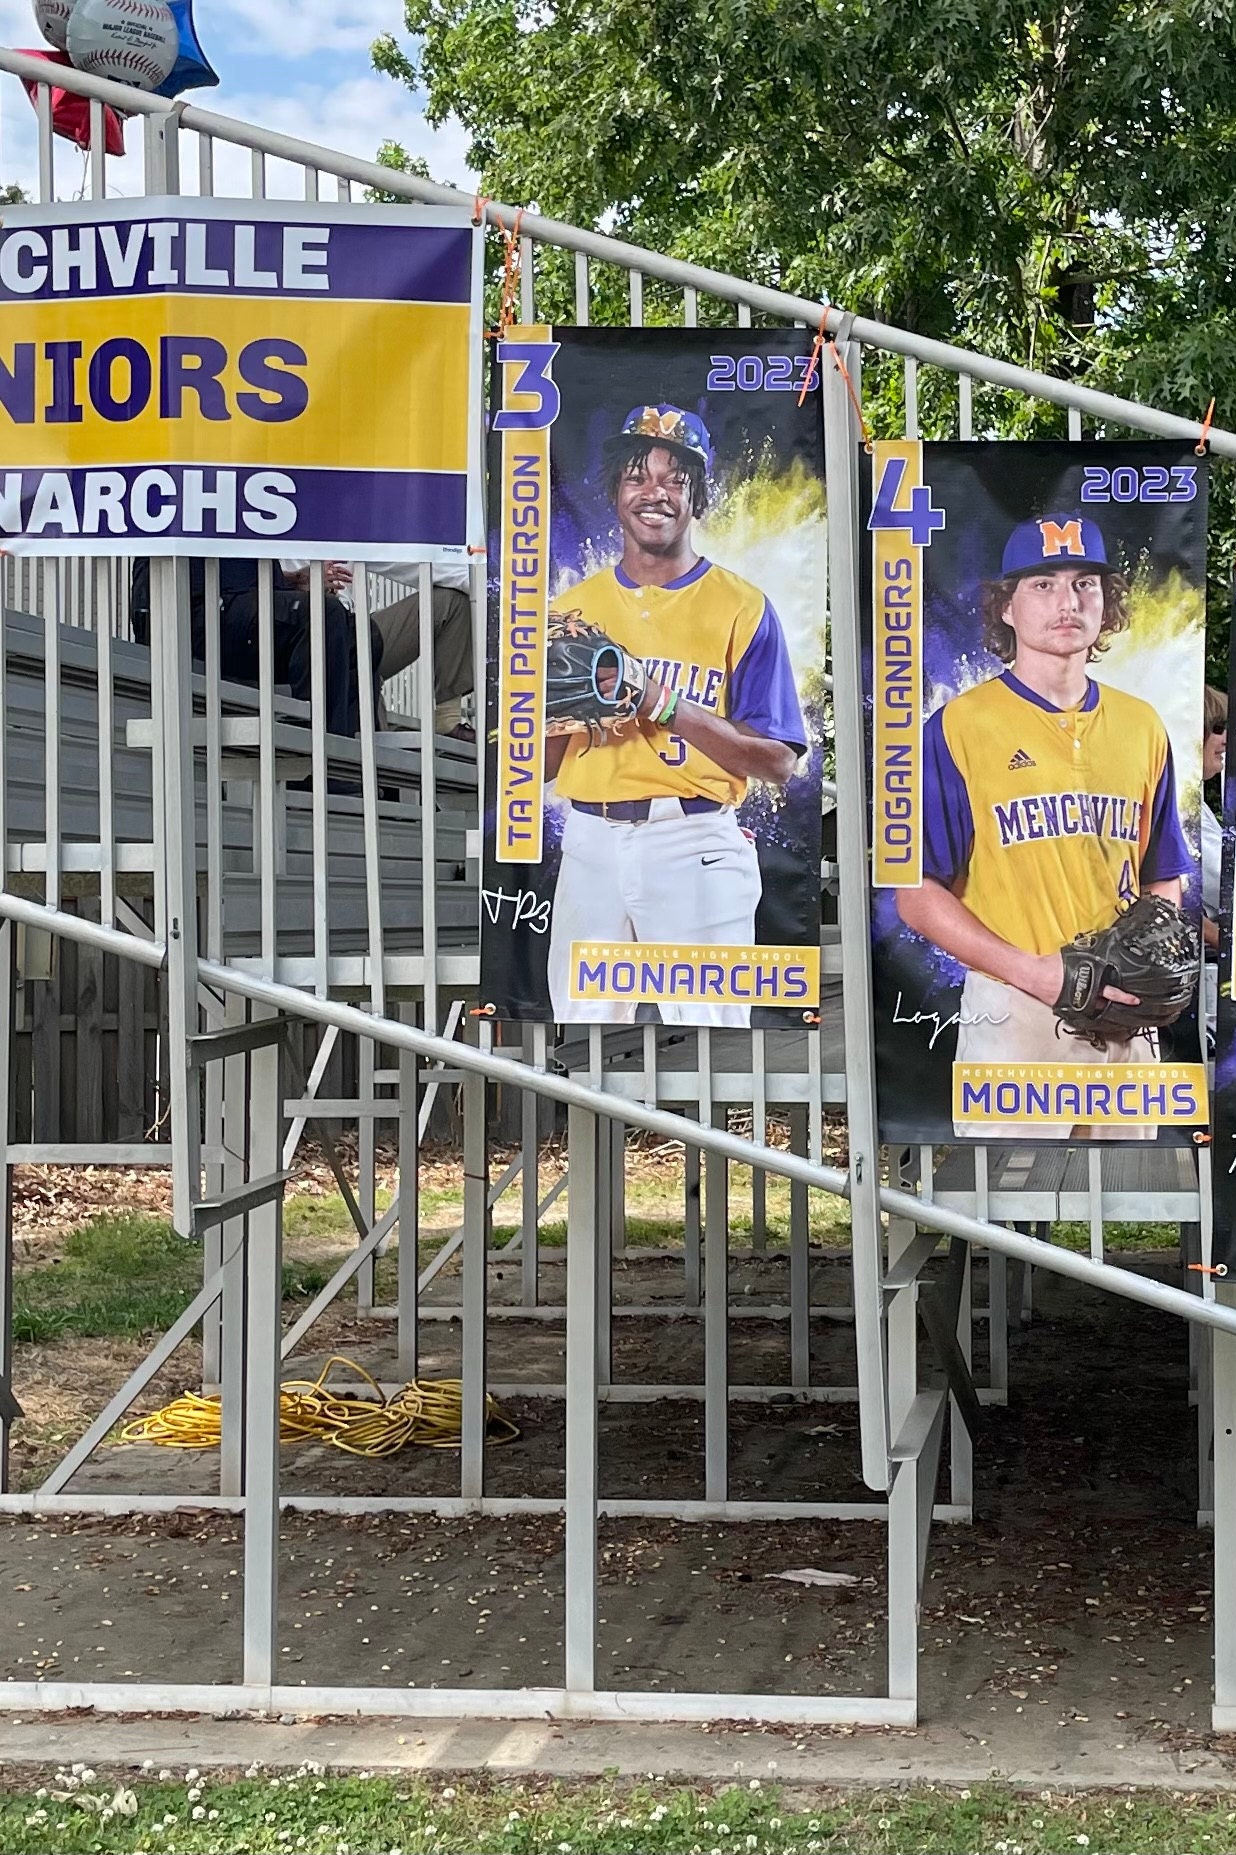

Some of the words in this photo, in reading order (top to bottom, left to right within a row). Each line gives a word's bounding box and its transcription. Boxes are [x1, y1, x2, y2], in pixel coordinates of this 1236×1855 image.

[102, 23, 122, 32] MAJOR
[493, 342, 561, 431] 3
[707, 355, 820, 392] 2023
[867, 457, 945, 547] 4
[1080, 467, 1198, 503] 2023
[1039, 519, 1085, 557] M
[510, 455, 541, 677] PATTERSON
[884, 558, 913, 730] LANDERS
[506, 692, 537, 847] TA'VEON
[884, 745, 913, 864] LOGAN
[579, 947, 679, 959] MENCHVILLE
[691, 951, 729, 960] HIGH
[740, 952, 802, 962] SCHOOL
[577, 960, 809, 998] MONARCHS
[892, 991, 1010, 1050] Logan
[962, 1069, 1064, 1078] MENCHVILLE
[1076, 1070, 1114, 1078] HIGH
[1126, 1070, 1189, 1079] SCHOOL
[961, 1081, 1198, 1116] MONARCHS
